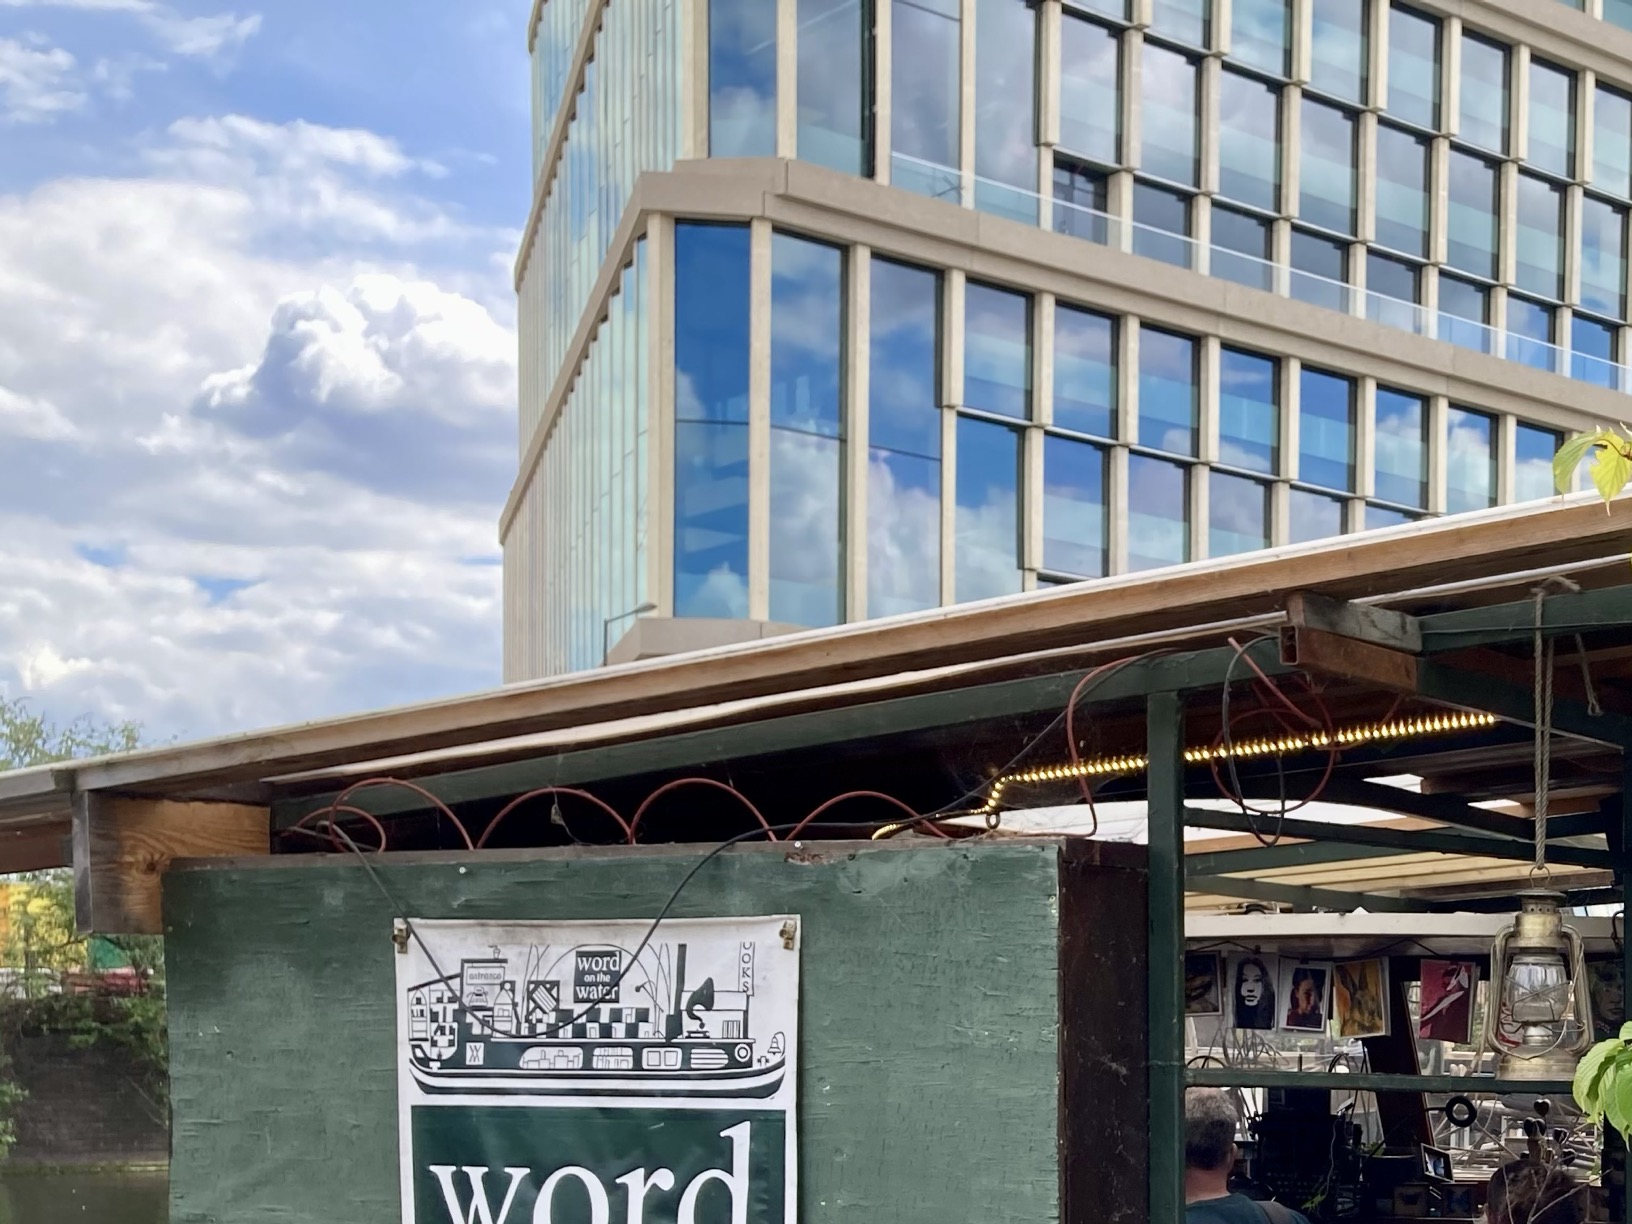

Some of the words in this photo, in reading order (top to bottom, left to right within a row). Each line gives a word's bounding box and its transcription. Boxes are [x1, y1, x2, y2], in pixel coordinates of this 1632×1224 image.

[577, 951, 620, 972] word
[584, 974, 596, 982] on
[597, 972, 611, 982] the
[575, 983, 619, 1000] water
